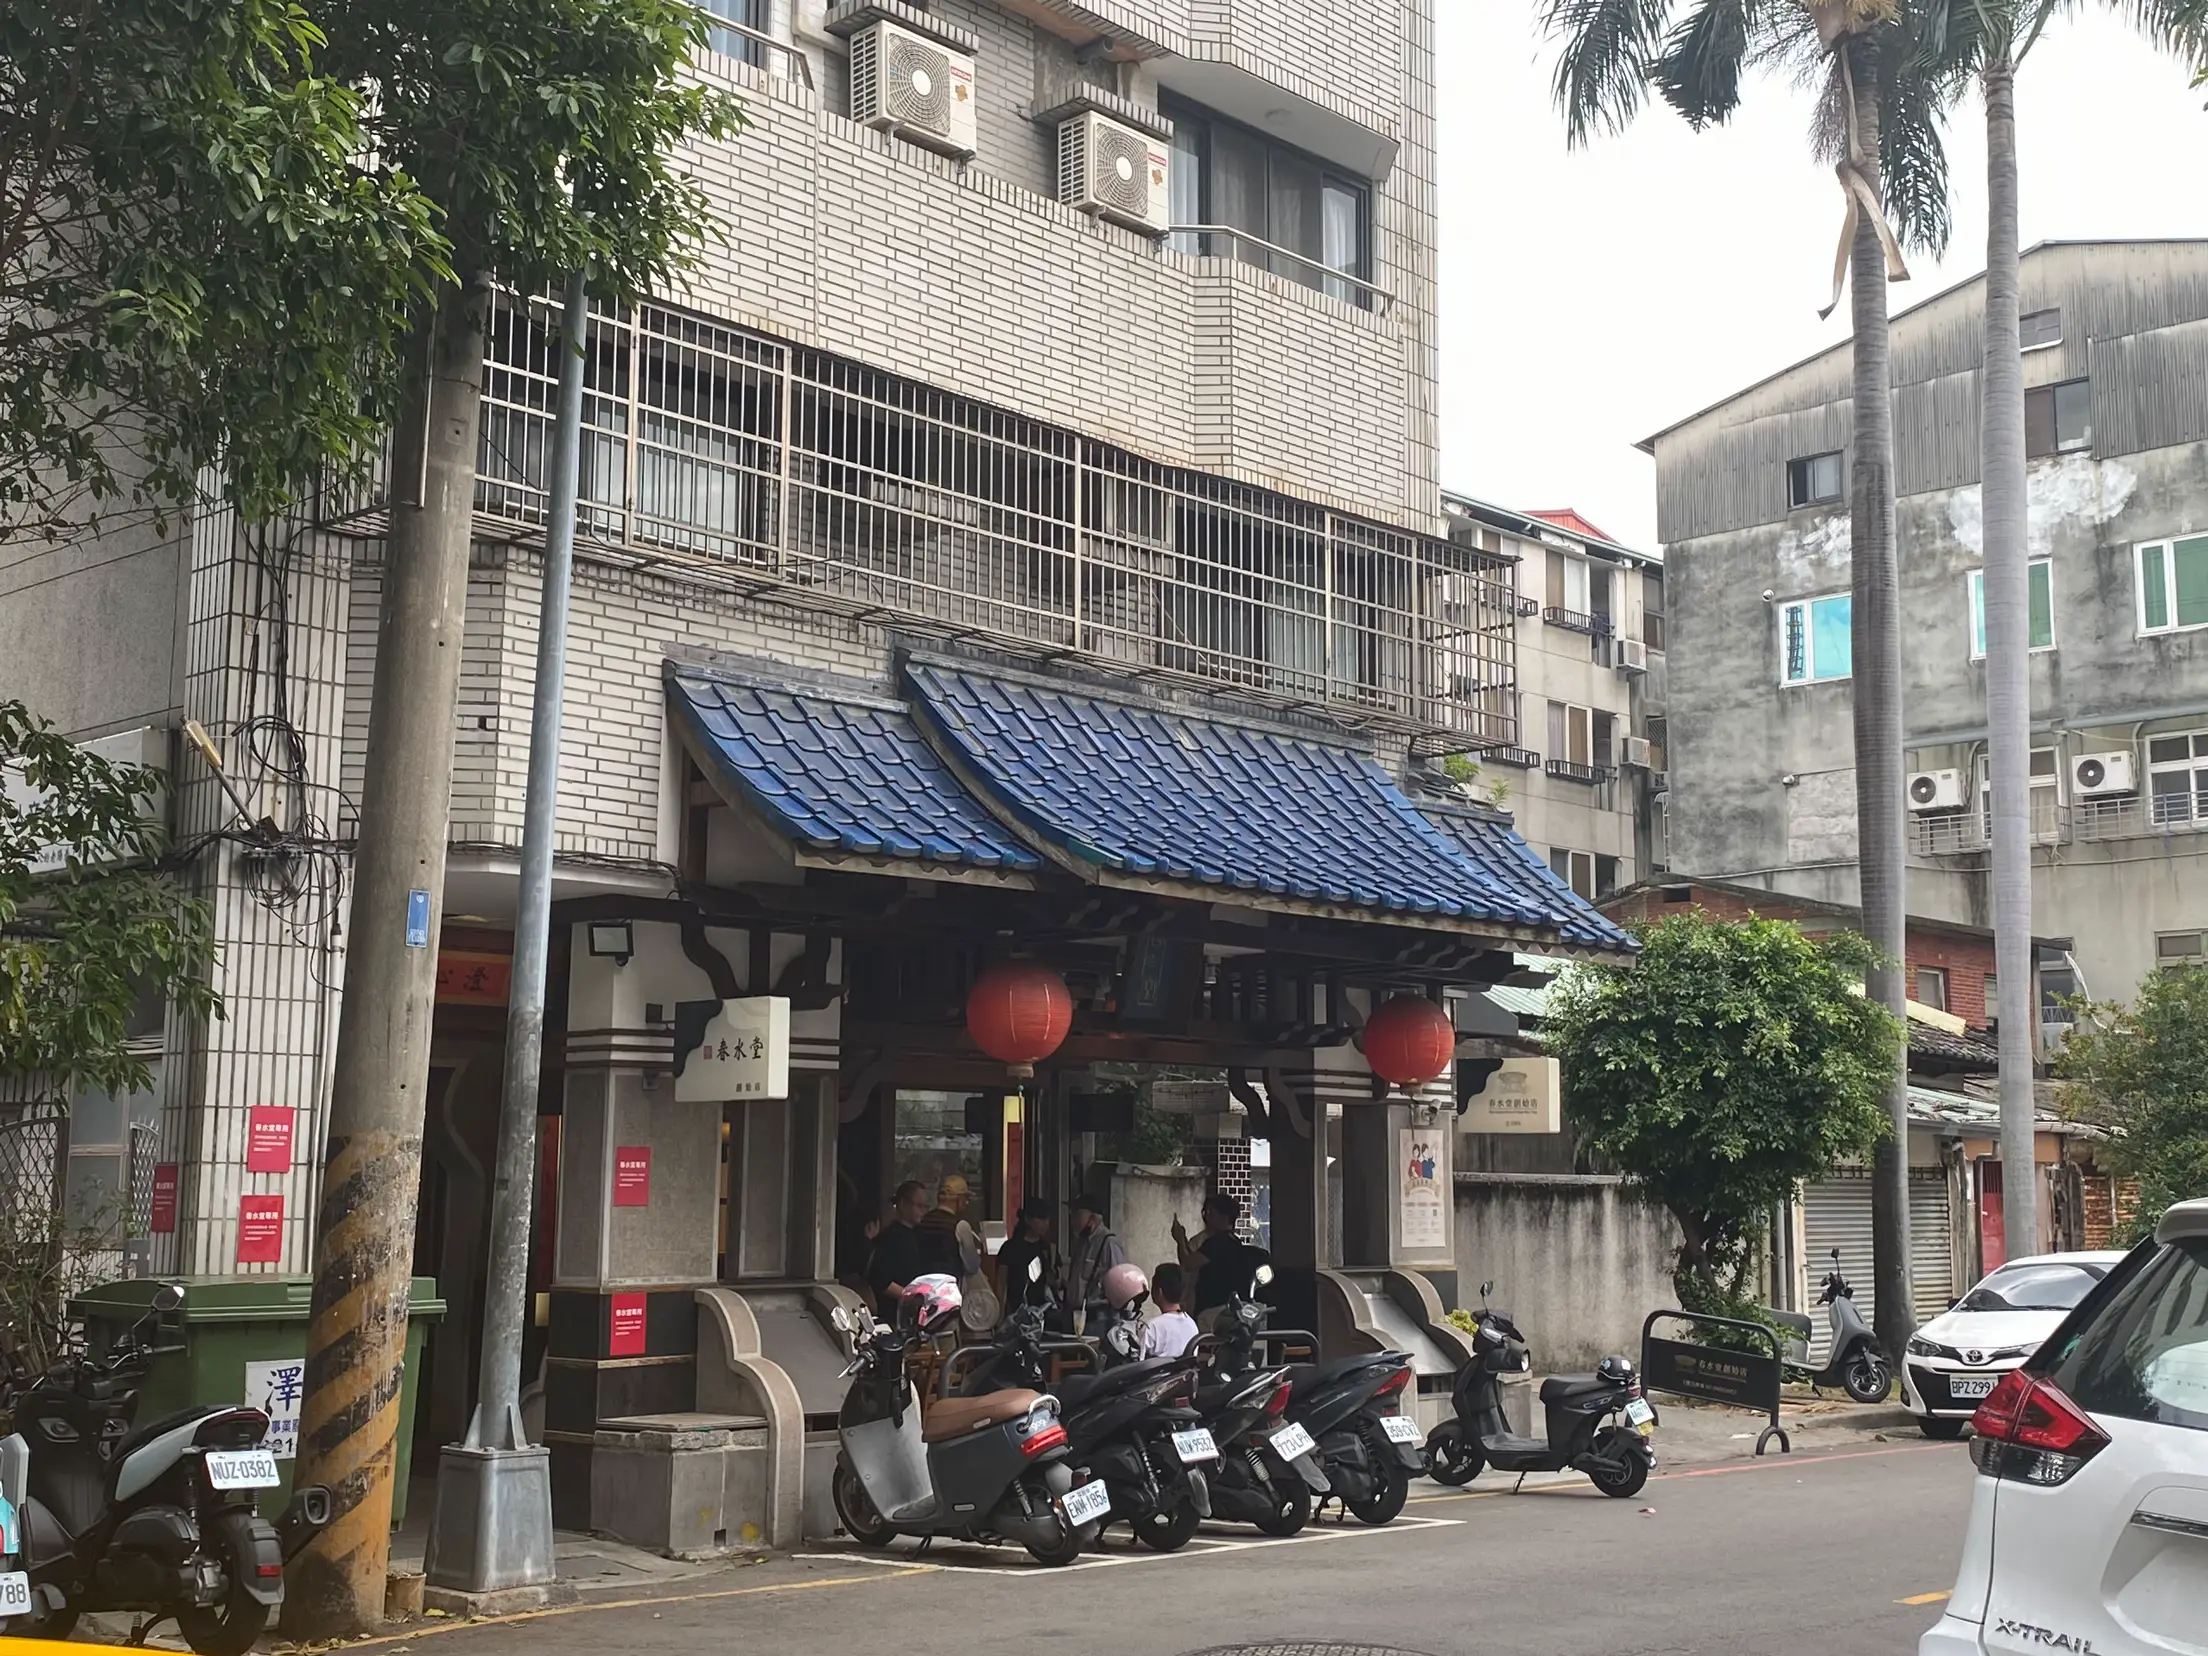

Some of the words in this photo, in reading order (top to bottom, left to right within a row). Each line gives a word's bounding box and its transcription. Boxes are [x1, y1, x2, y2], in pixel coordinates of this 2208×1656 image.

[716, 1036, 764, 1062] 春水堂
[1489, 1098, 1538, 1109] 春水堂創始店
[264, 1366, 303, 1418] 澤
[210, 1460, 275, 1480] NUZ-0382
[1994, 1616, 2103, 1656] X-TRAIL
